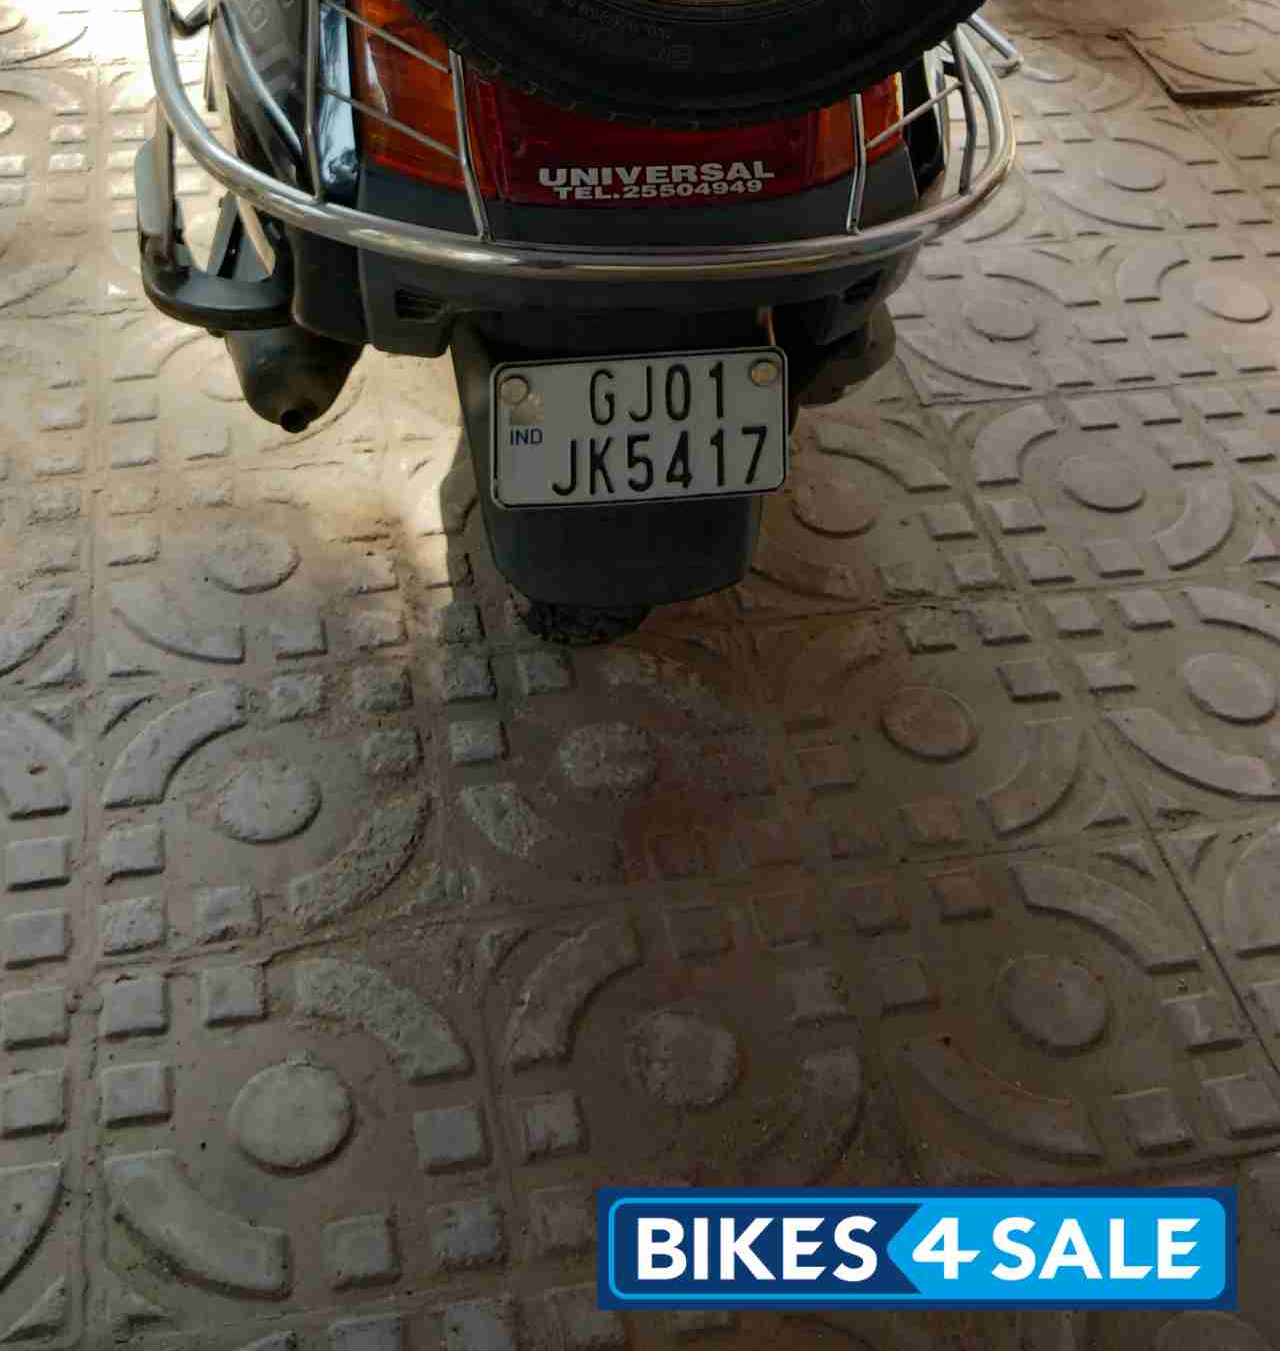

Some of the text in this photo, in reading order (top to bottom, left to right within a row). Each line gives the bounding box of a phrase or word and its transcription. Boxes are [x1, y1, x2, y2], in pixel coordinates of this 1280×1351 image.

[538, 160, 775, 187] UNIVERSAL
[554, 179, 763, 200] TEL.25504949
[589, 360, 724, 426] GJ01
[509, 428, 543, 445] IND
[551, 425, 768, 497] JK5417
